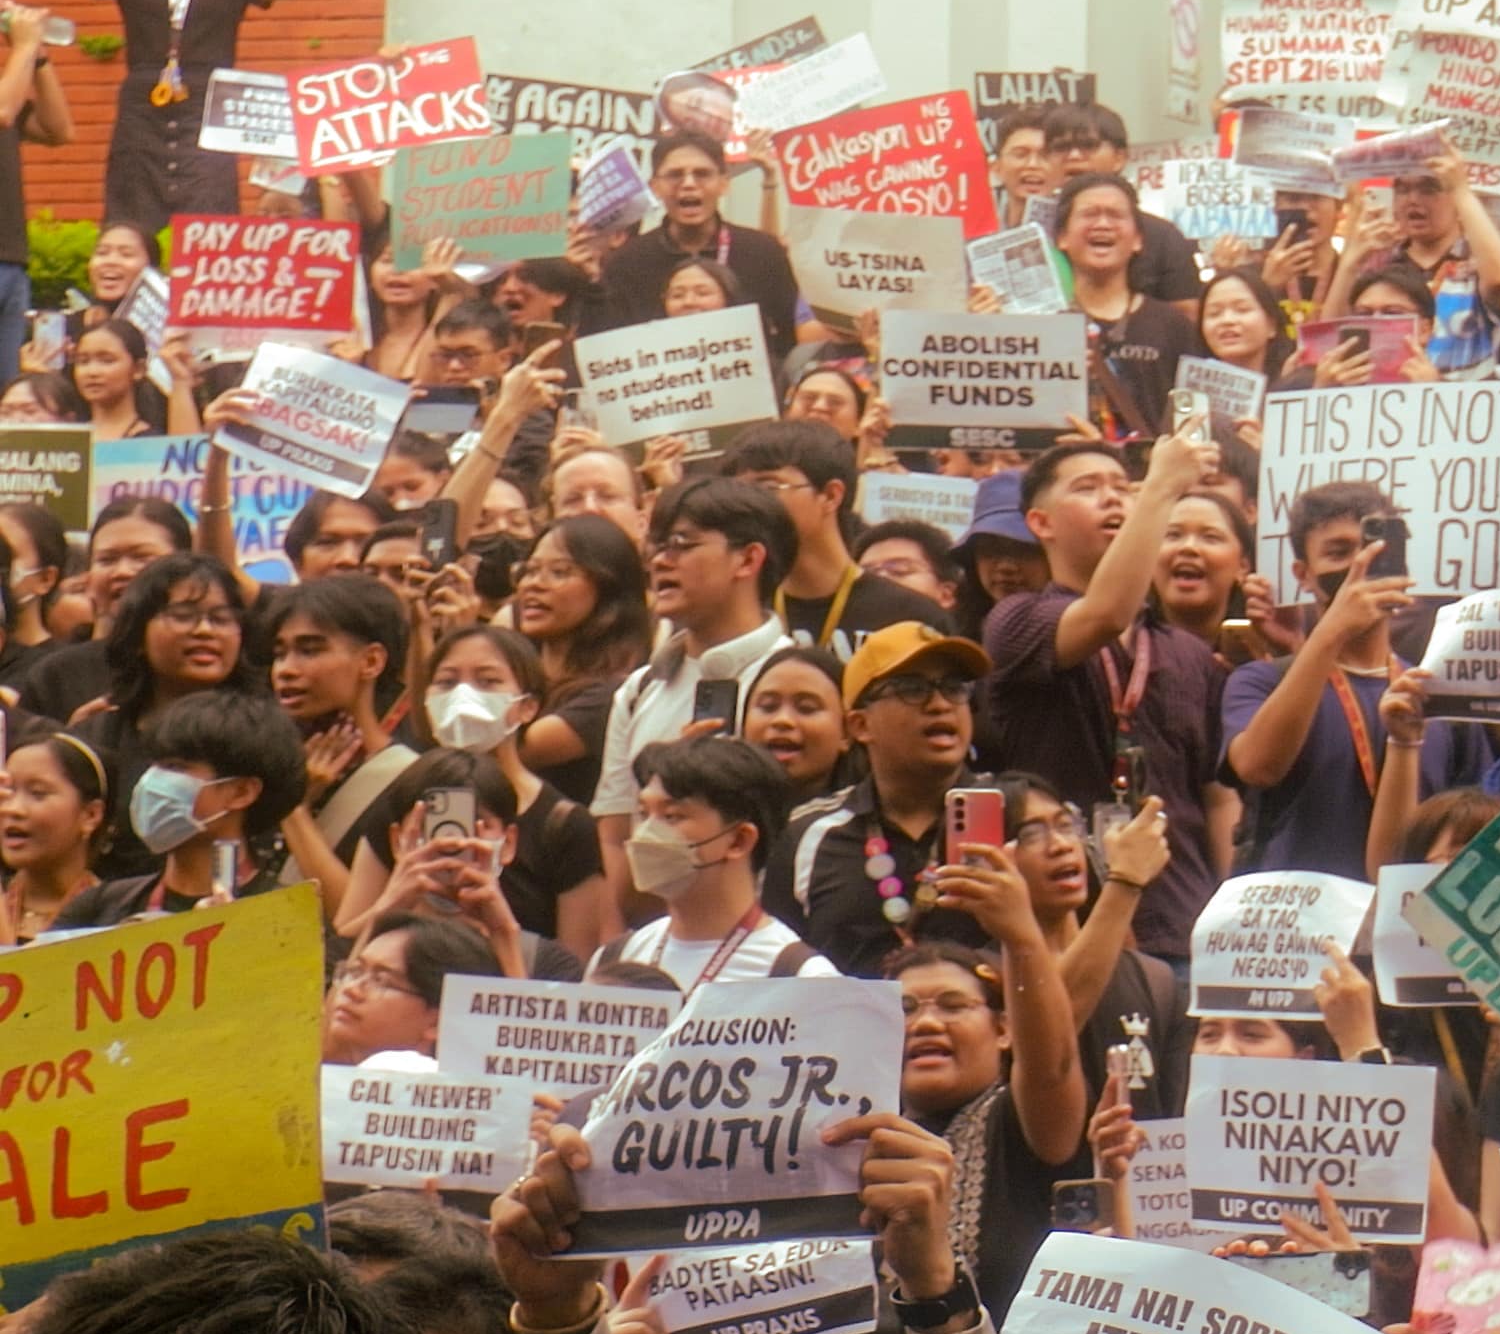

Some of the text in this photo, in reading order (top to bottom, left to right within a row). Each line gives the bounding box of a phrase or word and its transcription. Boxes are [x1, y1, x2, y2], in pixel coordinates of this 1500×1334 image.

[298, 49, 450, 115] STOP THE
[312, 83, 490, 162] ATTACKS
[182, 222, 351, 261] PAY UP FOR
[194, 256, 296, 287] LOSS &
[179, 277, 334, 321] DAMAGE!
[587, 337, 752, 380] Slots in majors:
[921, 334, 1039, 355] ABOLISH
[622, 369, 705, 397] student
[712, 360, 752, 381] left
[883, 359, 1081, 381] CONFIDENTIAL
[630, 391, 713, 422] behind!
[931, 386, 1034, 408] FUNDS
[950, 428, 1014, 448] SESC
[1221, 1089, 1406, 1129] ISOLI NIYO
[612, 1112, 803, 1175] GUILTY!
[1224, 1122, 1401, 1157] NINAKAW
[1259, 1155, 1357, 1189] NIYO!
[683, 1210, 762, 1242] UPPA
[1031, 1269, 1122, 1319] TAMA
[1130, 1290, 1195, 1328] NA!
